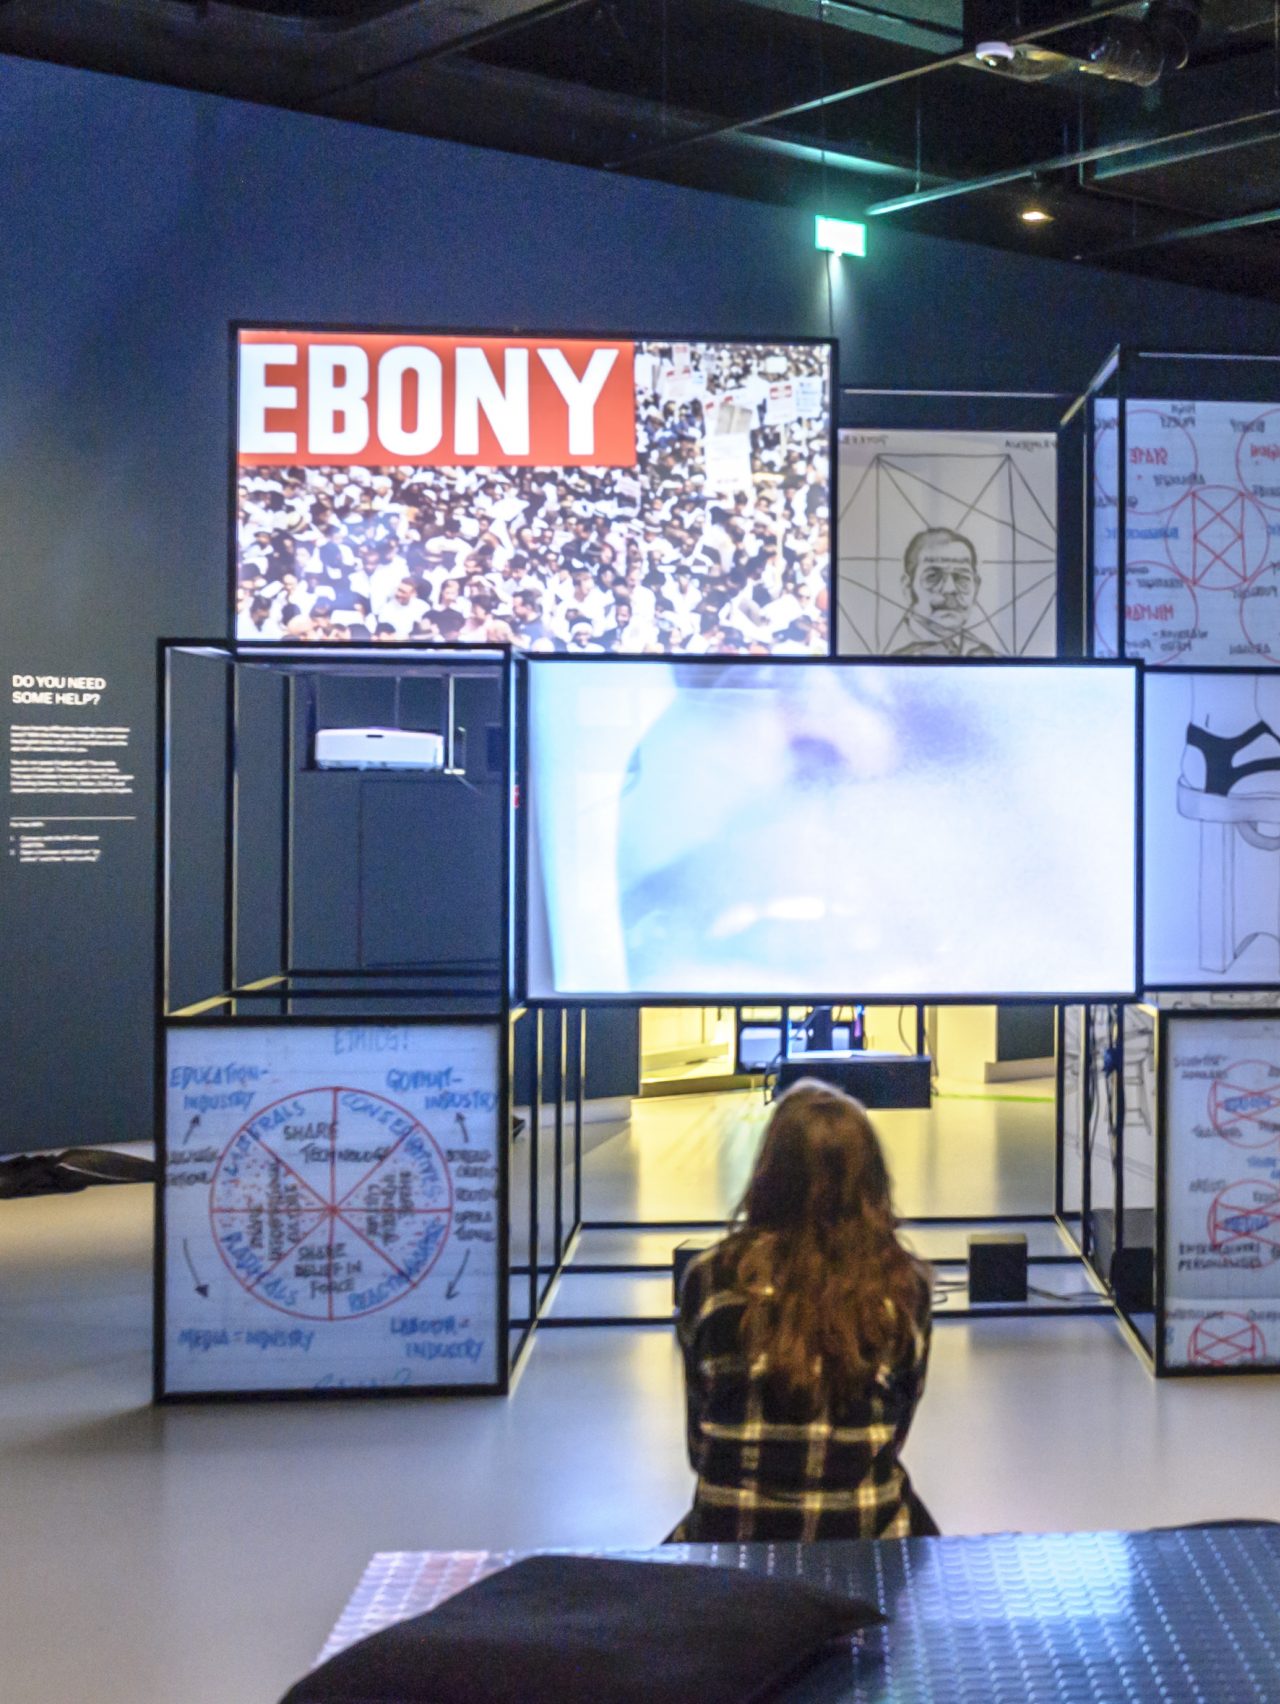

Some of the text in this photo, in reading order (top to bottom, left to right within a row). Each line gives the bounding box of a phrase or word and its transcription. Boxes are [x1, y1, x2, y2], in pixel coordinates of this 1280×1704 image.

[239, 343, 620, 457] EBONY
[12, 675, 107, 690] DO YOU NEED
[12, 691, 101, 706] SOME HELP?
